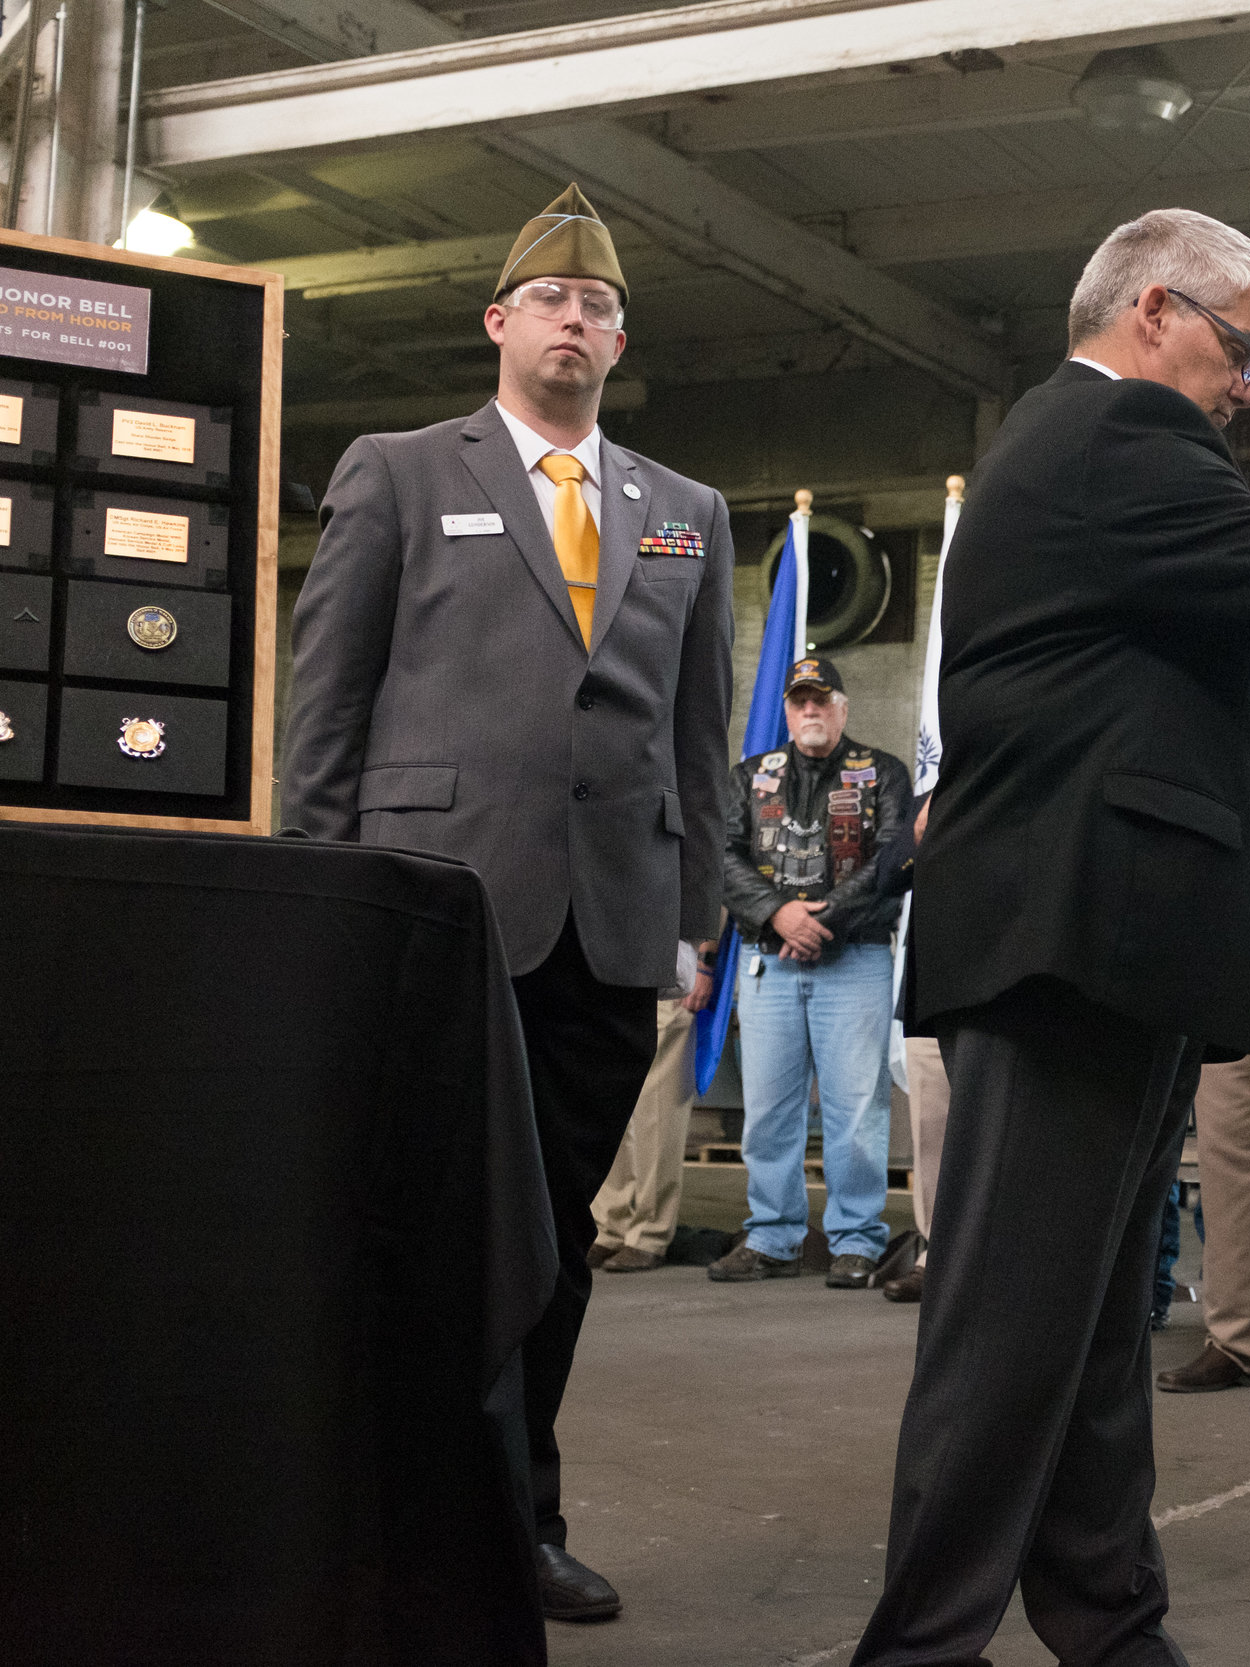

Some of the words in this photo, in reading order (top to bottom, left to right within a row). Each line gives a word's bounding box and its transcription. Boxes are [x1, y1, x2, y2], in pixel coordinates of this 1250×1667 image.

[0, 287, 72, 310] ONOR
[79, 299, 132, 319] BELL
[15, 306, 64, 323] FROM
[70, 315, 132, 333] HONOR
[22, 329, 51, 341] FOR
[60, 334, 94, 347] BELL
[98, 340, 132, 352] #001
